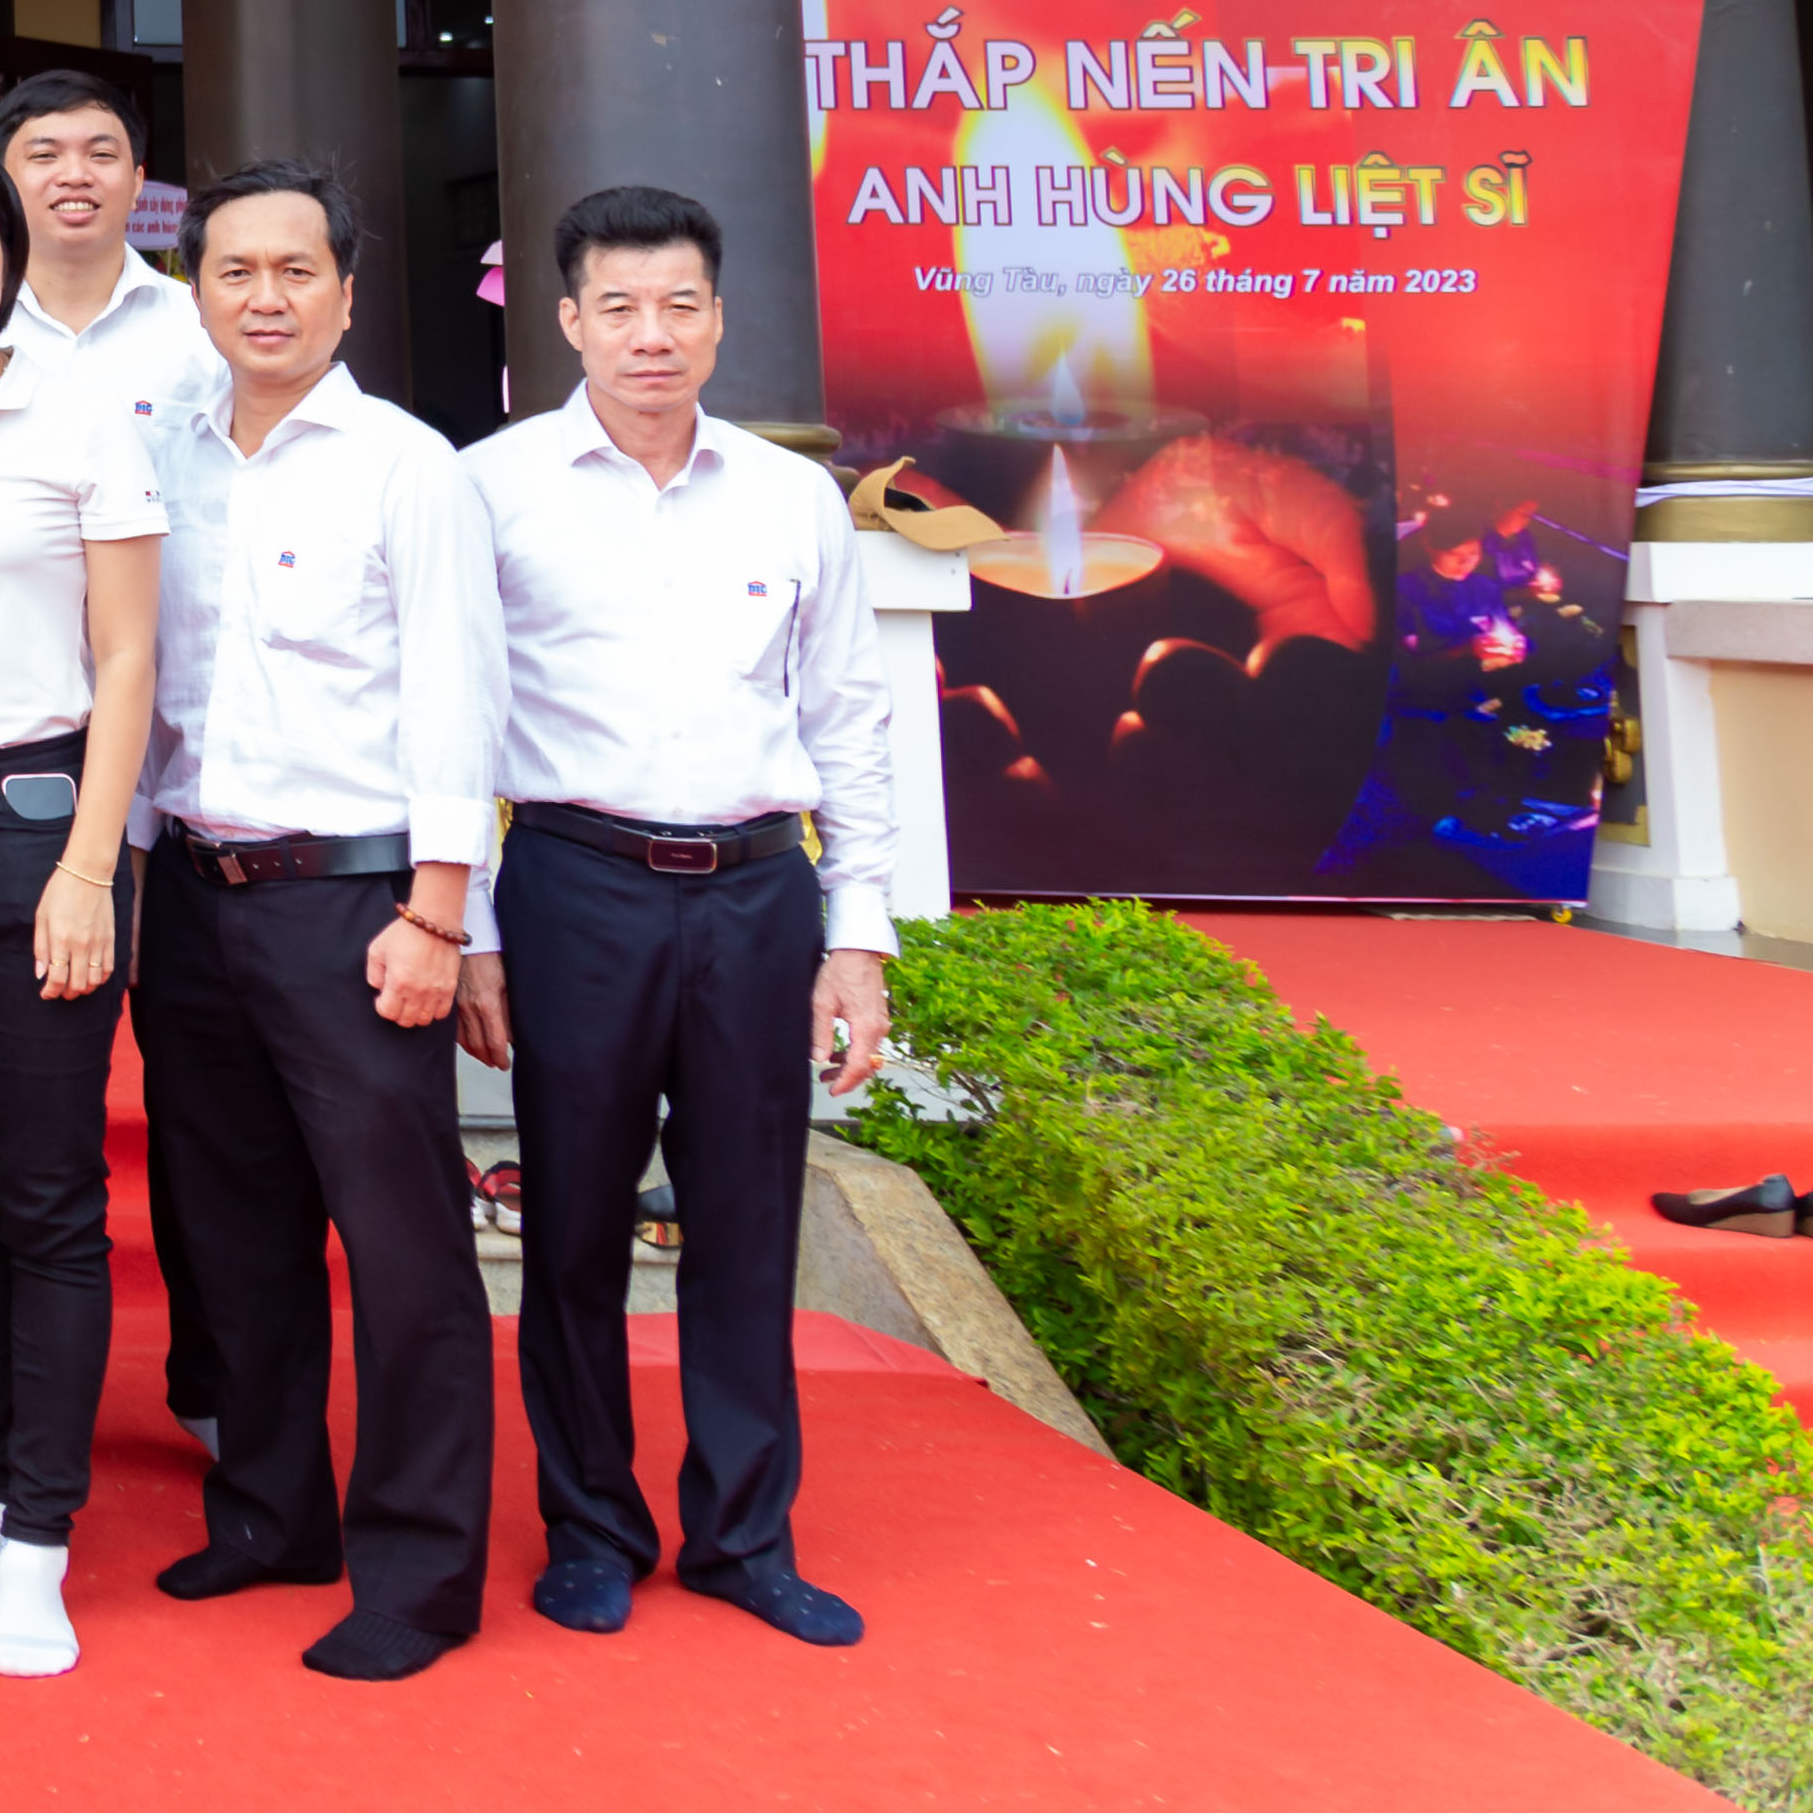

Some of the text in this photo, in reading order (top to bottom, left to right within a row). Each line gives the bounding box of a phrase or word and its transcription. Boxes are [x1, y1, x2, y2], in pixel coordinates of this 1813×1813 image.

[804, 6, 1590, 112] THẮP NẾN TRI ÂN
[846, 148, 1532, 241] ANH HÙNG LIỆT SĨ
[913, 264, 1479, 299] Vũng Tàu, ngày 26 tháng 7 năm 2023
